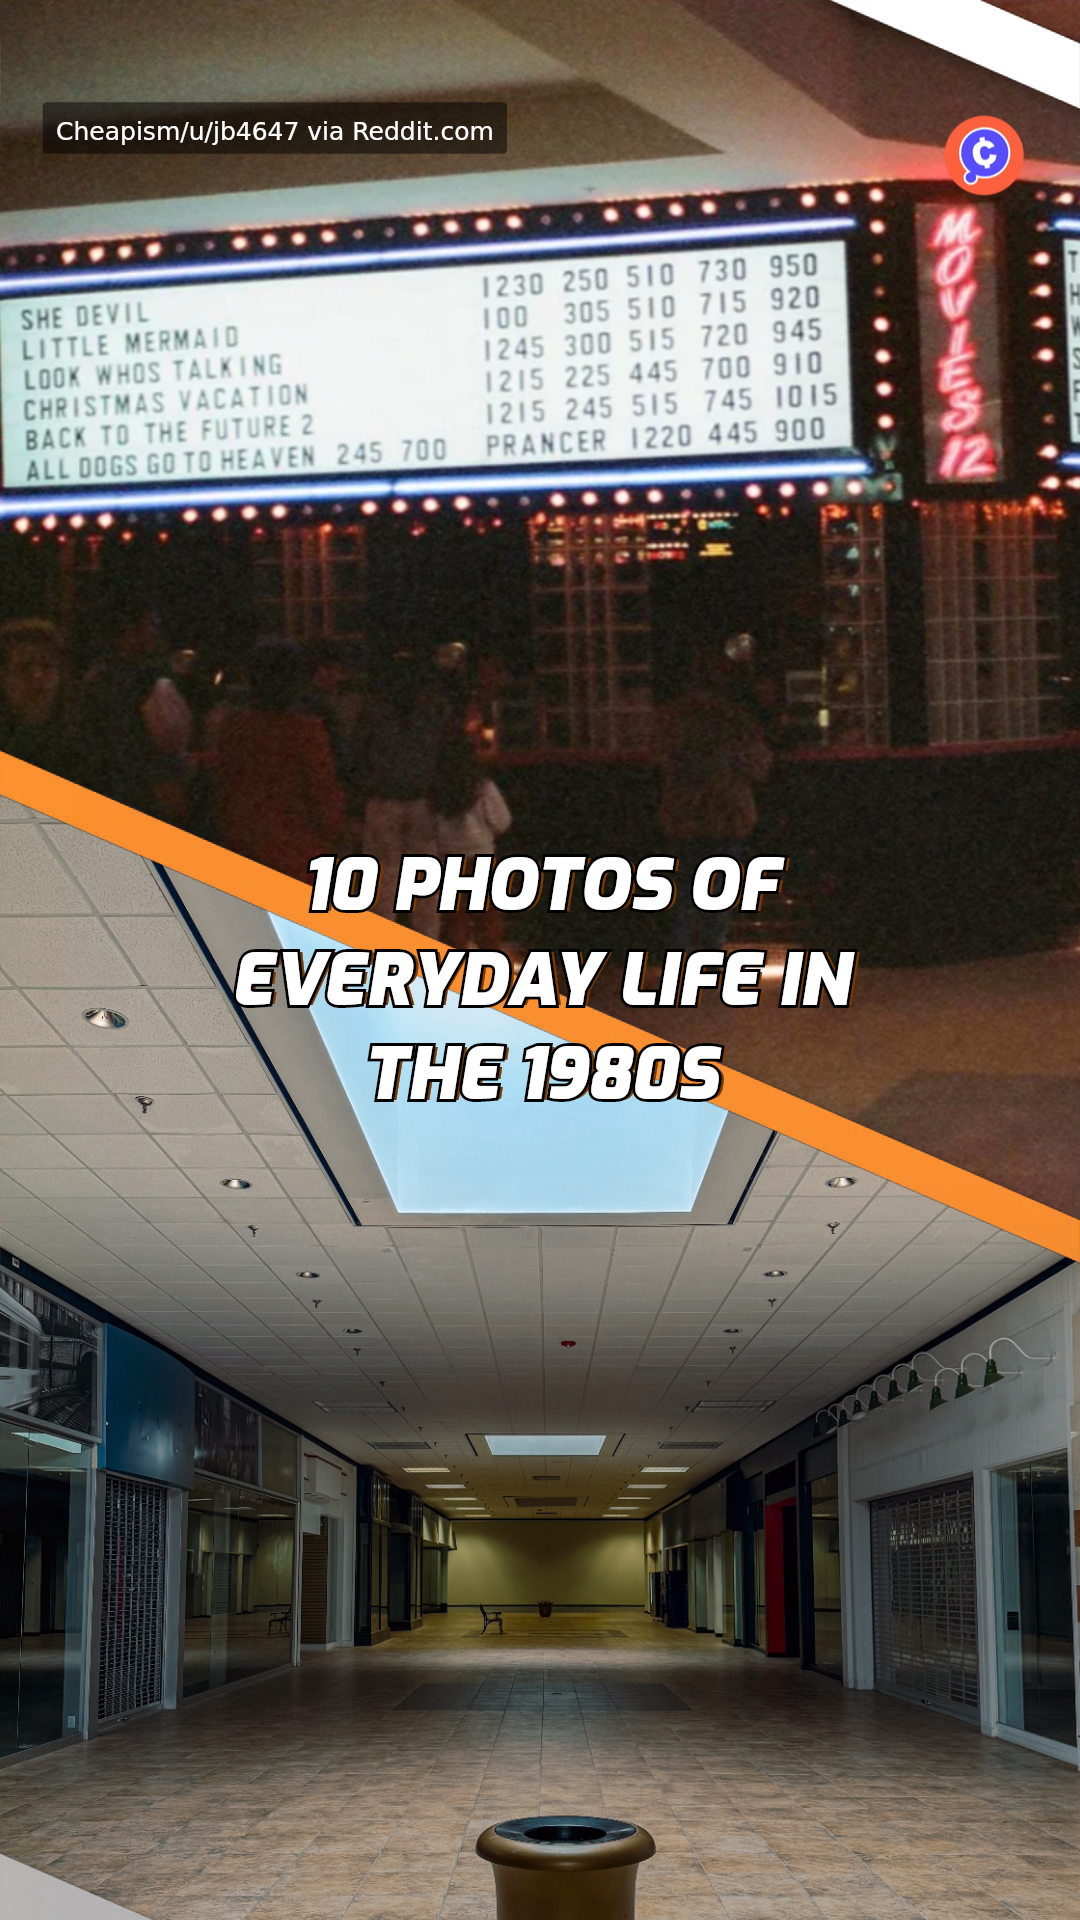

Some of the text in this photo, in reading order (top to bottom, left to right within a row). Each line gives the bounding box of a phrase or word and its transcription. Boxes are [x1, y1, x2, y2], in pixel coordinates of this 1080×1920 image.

[20, 252, 818, 331] SHE DEVIL 1230 250 510 730 950
[22, 284, 820, 361] LITTLE MERMAID 100 305 510 715 920
[931, 206, 983, 433] MOVIES
[23, 350, 822, 422] CHRISTMAS VACATION 1215 225 445 700 910
[24, 317, 822, 391] LOOK WHOS TALKING 1245 300 515 720 945
[25, 382, 838, 452] BACK TO THE FUTURE 2 1215 245 515 745 1015
[486, 416, 826, 457] PRANCER 1220 445 900
[26, 438, 446, 482] ALL DOGS GO TO HEAVEN 245 700
[939, 432, 996, 478] 12
